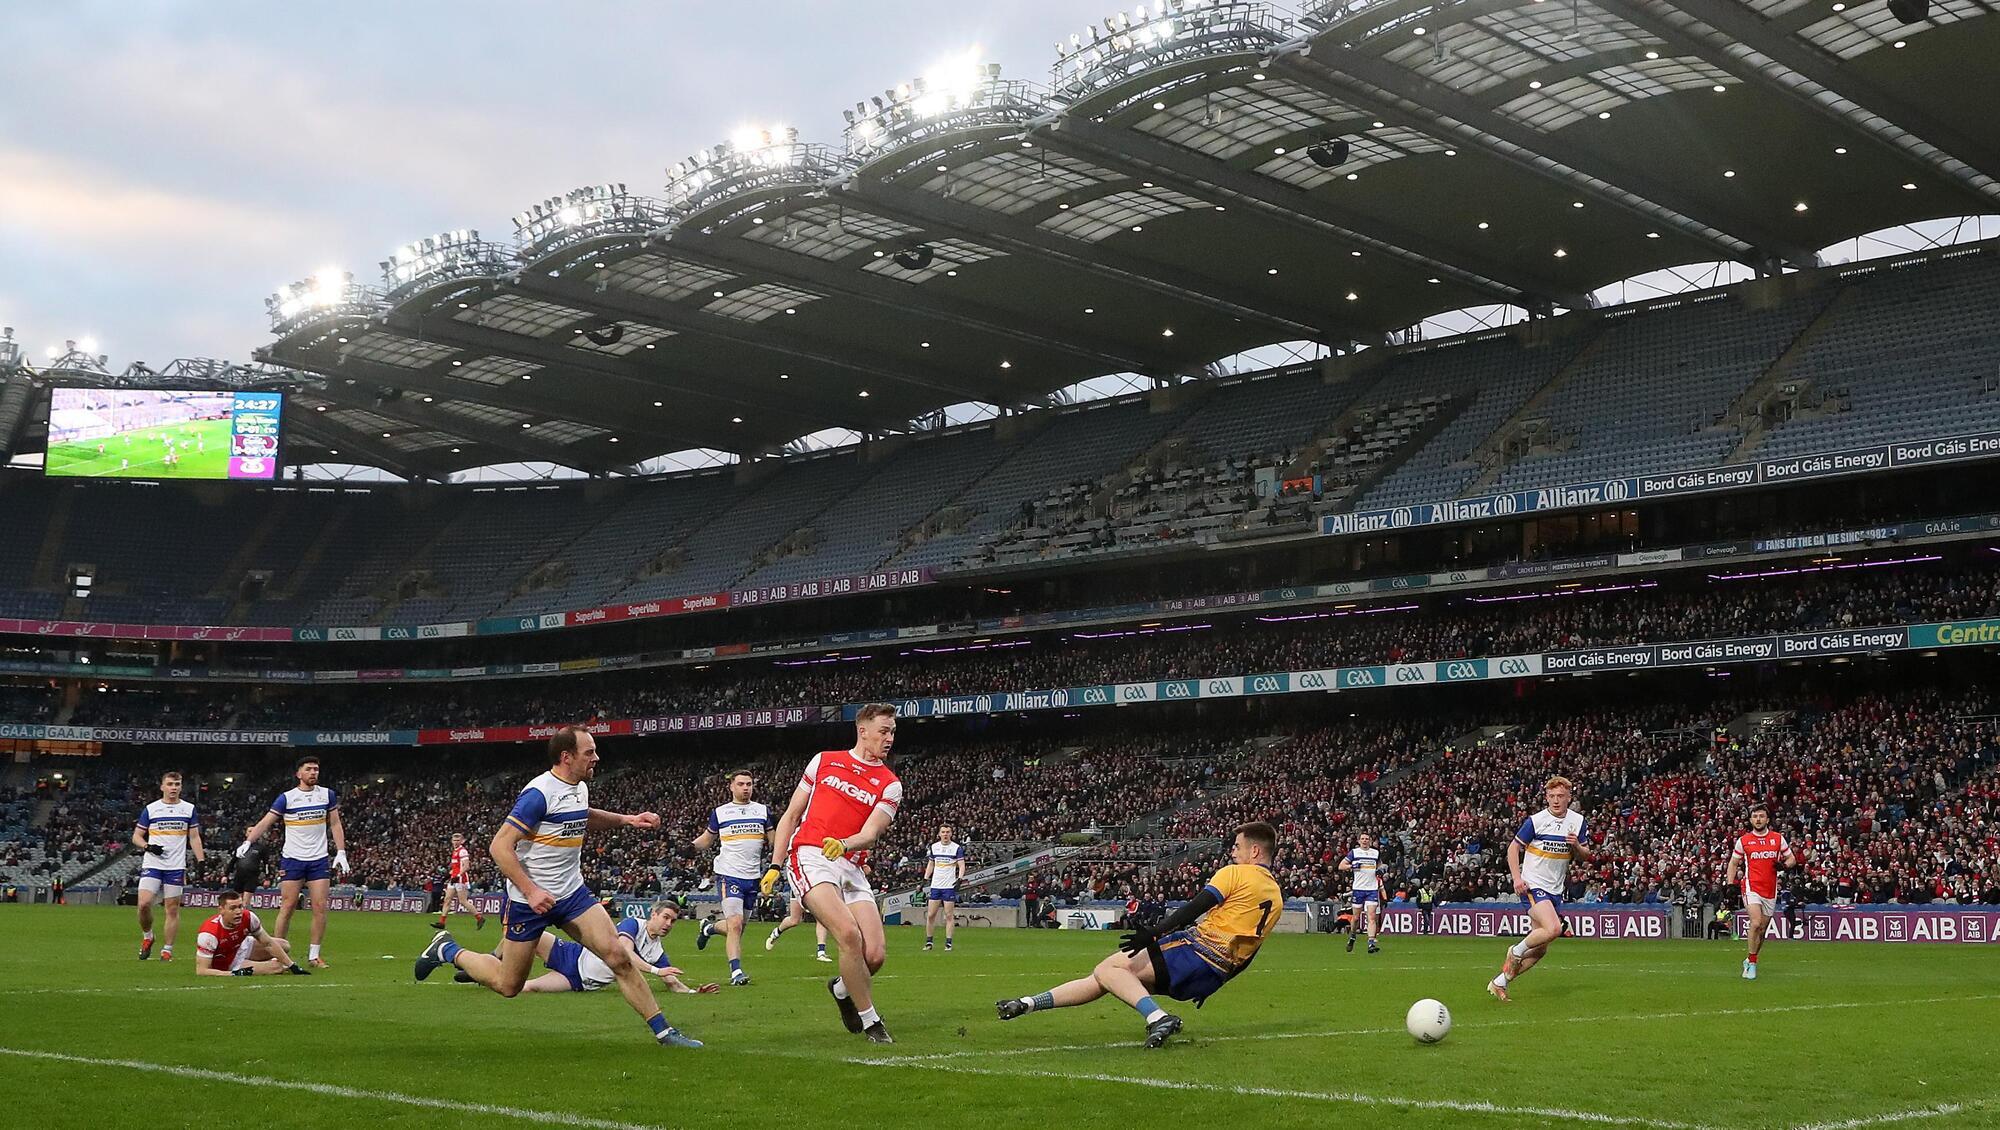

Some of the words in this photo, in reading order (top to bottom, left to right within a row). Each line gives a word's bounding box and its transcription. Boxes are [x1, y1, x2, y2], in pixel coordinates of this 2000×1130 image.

[234, 400, 278, 410] 24:27
[1897, 444, 1932, 460] Bord
[1934, 440, 1966, 456] Gáis
[1969, 438, 2000, 452] Ene
[1767, 462, 1799, 477] Bord
[1802, 457, 1831, 473] Gáis
[1834, 451, 1884, 469] Energy
[1644, 476, 1675, 492] Bord
[1677, 472, 1704, 488] Gáis
[1707, 468, 1754, 485] Energy
[1536, 486, 1600, 510] Allianz
[1430, 501, 1490, 523] Allianz
[1332, 513, 1388, 534] Allianz
[1925, 521, 1960, 533] GAA.ie
[1706, 545, 1737, 555] Glenveagh
[1765, 539, 1785, 550] FANS
[1787, 538, 1797, 548] OF
[1797, 536, 1812, 547] THE
[1534, 566, 1547, 574] PARK
[869, 575, 887, 588] AIB
[900, 570, 919, 585] AIB
[802, 583, 818, 596] AIB
[833, 579, 851, 593] AIB
[742, 590, 758, 603] AIB
[770, 587, 787, 600] AIB
[1223, 596, 1236, 604] AIB
[1247, 594, 1260, 602] AIB
[628, 602, 660, 617] SuperValu
[683, 596, 717, 610] SuperValu
[1170, 602, 1183, 610] AIB
[1193, 599, 1206, 607] AIB
[575, 610, 606, 624] SuperValu
[1784, 636, 1817, 652] Bord
[1820, 633, 1850, 649] Gáis
[1853, 631, 1904, 648] Energy
[1661, 647, 1692, 661] Bord
[1695, 643, 1722, 658] Gáis
[1725, 640, 1773, 657] Energy
[1499, 659, 1530, 674] GAA
[1547, 656, 1577, 668] Bord
[1578, 653, 1604, 667] Gáis
[1606, 651, 1651, 665] Energy
[1347, 669, 1375, 685] GAA
[1396, 666, 1425, 682] GAA
[1447, 662, 1478, 679] GAA
[1253, 676, 1280, 692] GAA
[1300, 672, 1327, 688] GAA
[1123, 686, 1147, 700] GAA
[1165, 683, 1191, 698] GAA
[1209, 680, 1234, 695] GAA
[1004, 692, 1049, 710] Allianz
[1083, 688, 1107, 703] GAA
[931, 698, 974, 715] Allianz
[698, 716, 714, 728] AIB
[725, 714, 742, 727] AIB
[755, 711, 772, 724] AIB
[786, 709, 803, 723] AIB
[642, 719, 658, 732] AIB
[668, 718, 684, 730] AIB
[0, 725, 44, 739] GAA.ie
[47, 727, 91, 740] GAA.ie
[93, 730, 133, 741] CROKE
[136, 731, 164, 741] PARK
[165, 731, 227, 743] MEETINGS
[229, 732, 238, 743] &
[240, 732, 289, 743] EVENTS
[316, 733, 341, 743] GAA
[343, 733, 390, 743] MUSEUM
[450, 730, 485, 742] SuperValu
[821, 775, 877, 807] AMGEN
[1750, 850, 1778, 859] AMGEN
[190, 894, 203, 907] AIB
[330, 900, 343, 910] AIB
[369, 900, 382, 911] AIB
[389, 900, 402, 911] AIB
[411, 900, 423, 911] AIB
[484, 898, 501, 913] AIB
[626, 904, 646, 919] GAA
[1320, 905, 1330, 916] 33
[1686, 908, 1698, 920] 34
[1258, 899, 1273, 938] 1
[1380, 913, 1413, 933] AIB
[1437, 914, 1472, 934] AIB
[1497, 914, 1532, 935] AIB
[1604, 928, 1616, 936] AIB
[1623, 916, 1662, 938] AIB
[1813, 929, 1826, 937] AIB
[1835, 917, 1879, 940] AIB
[1889, 930, 1903, 938] AIB
[1912, 917, 1957, 940] AIB
[1967, 930, 1981, 939] AIB
